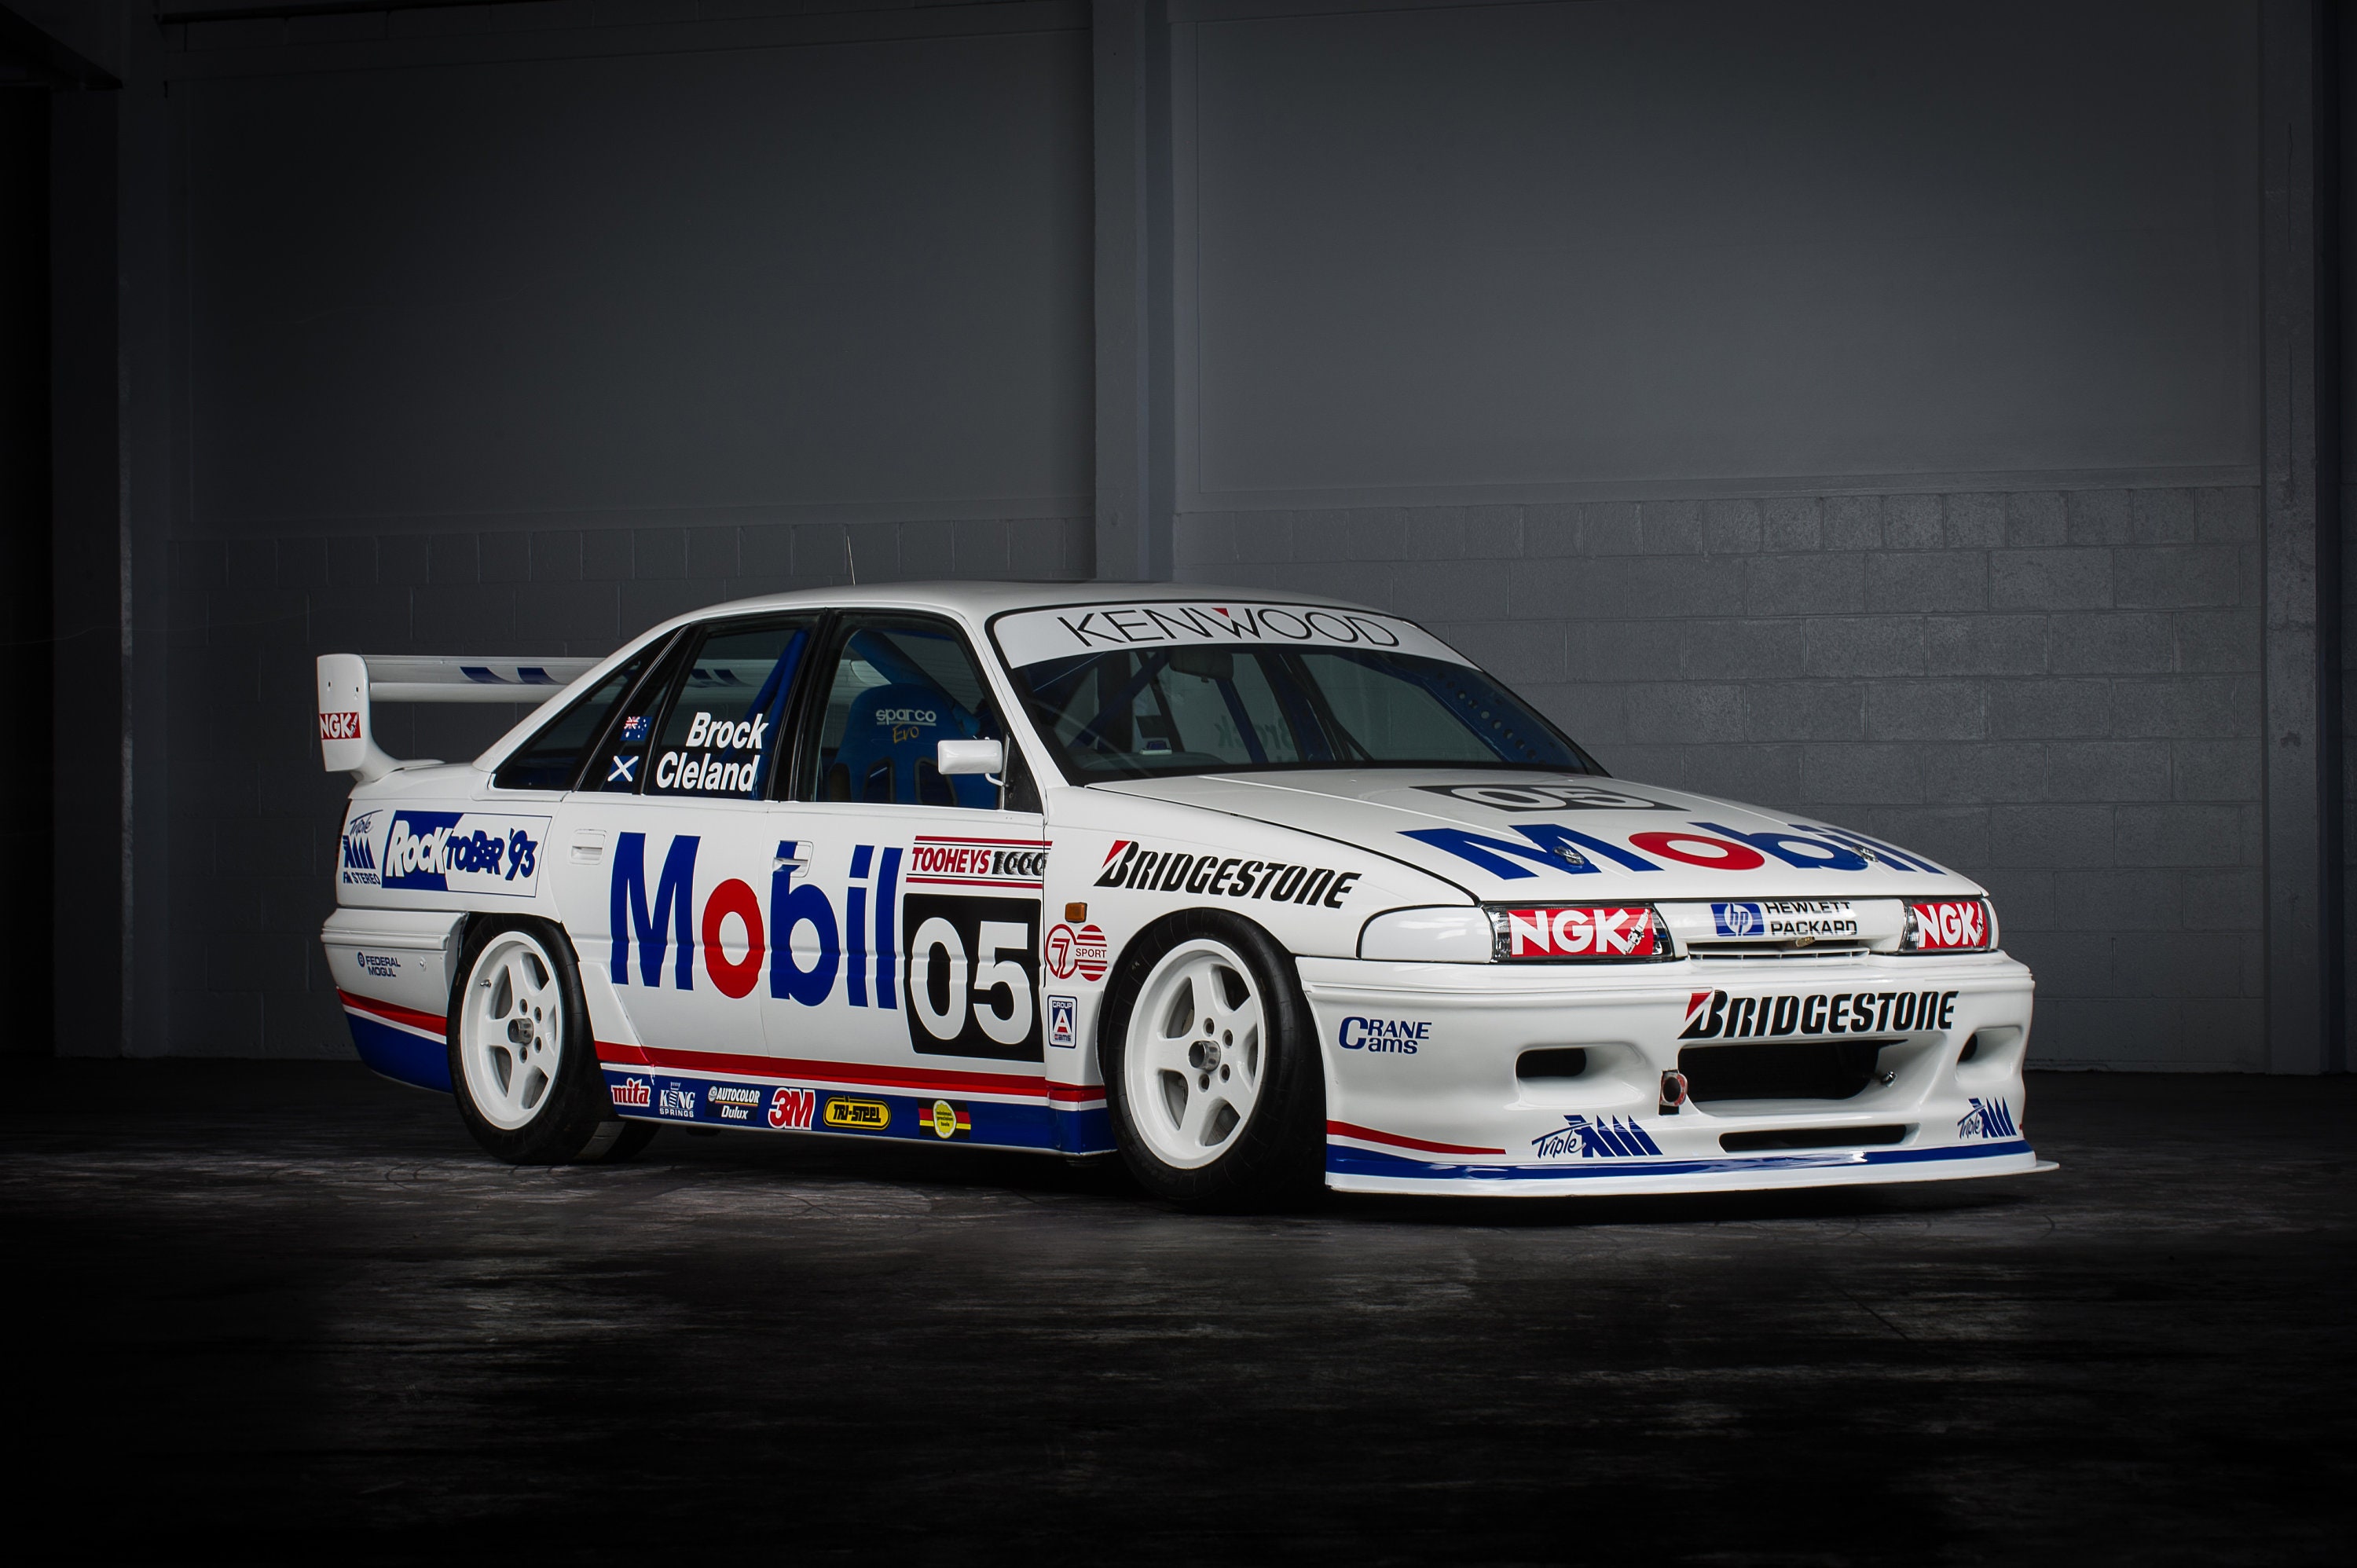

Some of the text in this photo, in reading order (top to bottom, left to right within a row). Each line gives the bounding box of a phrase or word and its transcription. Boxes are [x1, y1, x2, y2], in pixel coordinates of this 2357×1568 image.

[1057, 607, 1400, 648] KENWOOD
[320, 713, 352, 738] NGK
[686, 712, 768, 749] Brock
[876, 709, 937, 726] sparco
[656, 752, 761, 791] Cleland
[1451, 786, 1655, 808] 05
[912, 847, 992, 874] TOOHEYS
[1396, 822, 1948, 881] Mobil
[351, 872, 381, 885] STEREO
[1093, 840, 1362, 909] BRIDGESTONE
[610, 831, 903, 1010] Mobil
[1764, 901, 1850, 914] HEWLETT
[1508, 908, 1630, 955] NGK
[1769, 920, 1857, 936] PACKARD
[1912, 903, 1977, 948] NGK
[365, 955, 401, 968] FEDERAL
[1075, 947, 1107, 958] SPORT
[368, 966, 397, 977] MOGUL
[910, 917, 1033, 1045] 05
[1053, 1009, 1072, 1033] A
[1677, 989, 1959, 1039] BRIDGESTONE
[1339, 1016, 1432, 1050] CRANE
[611, 1078, 651, 1107] mita
[716, 1087, 761, 1104] AUTOCOLOR
[659, 1108, 694, 1118] SPRINGS
[721, 1105, 749, 1119] Dulux
[768, 1086, 816, 1130] 3M
[832, 1104, 882, 1123] TRI-STEEL
[1532, 1123, 1593, 1159] Triple
